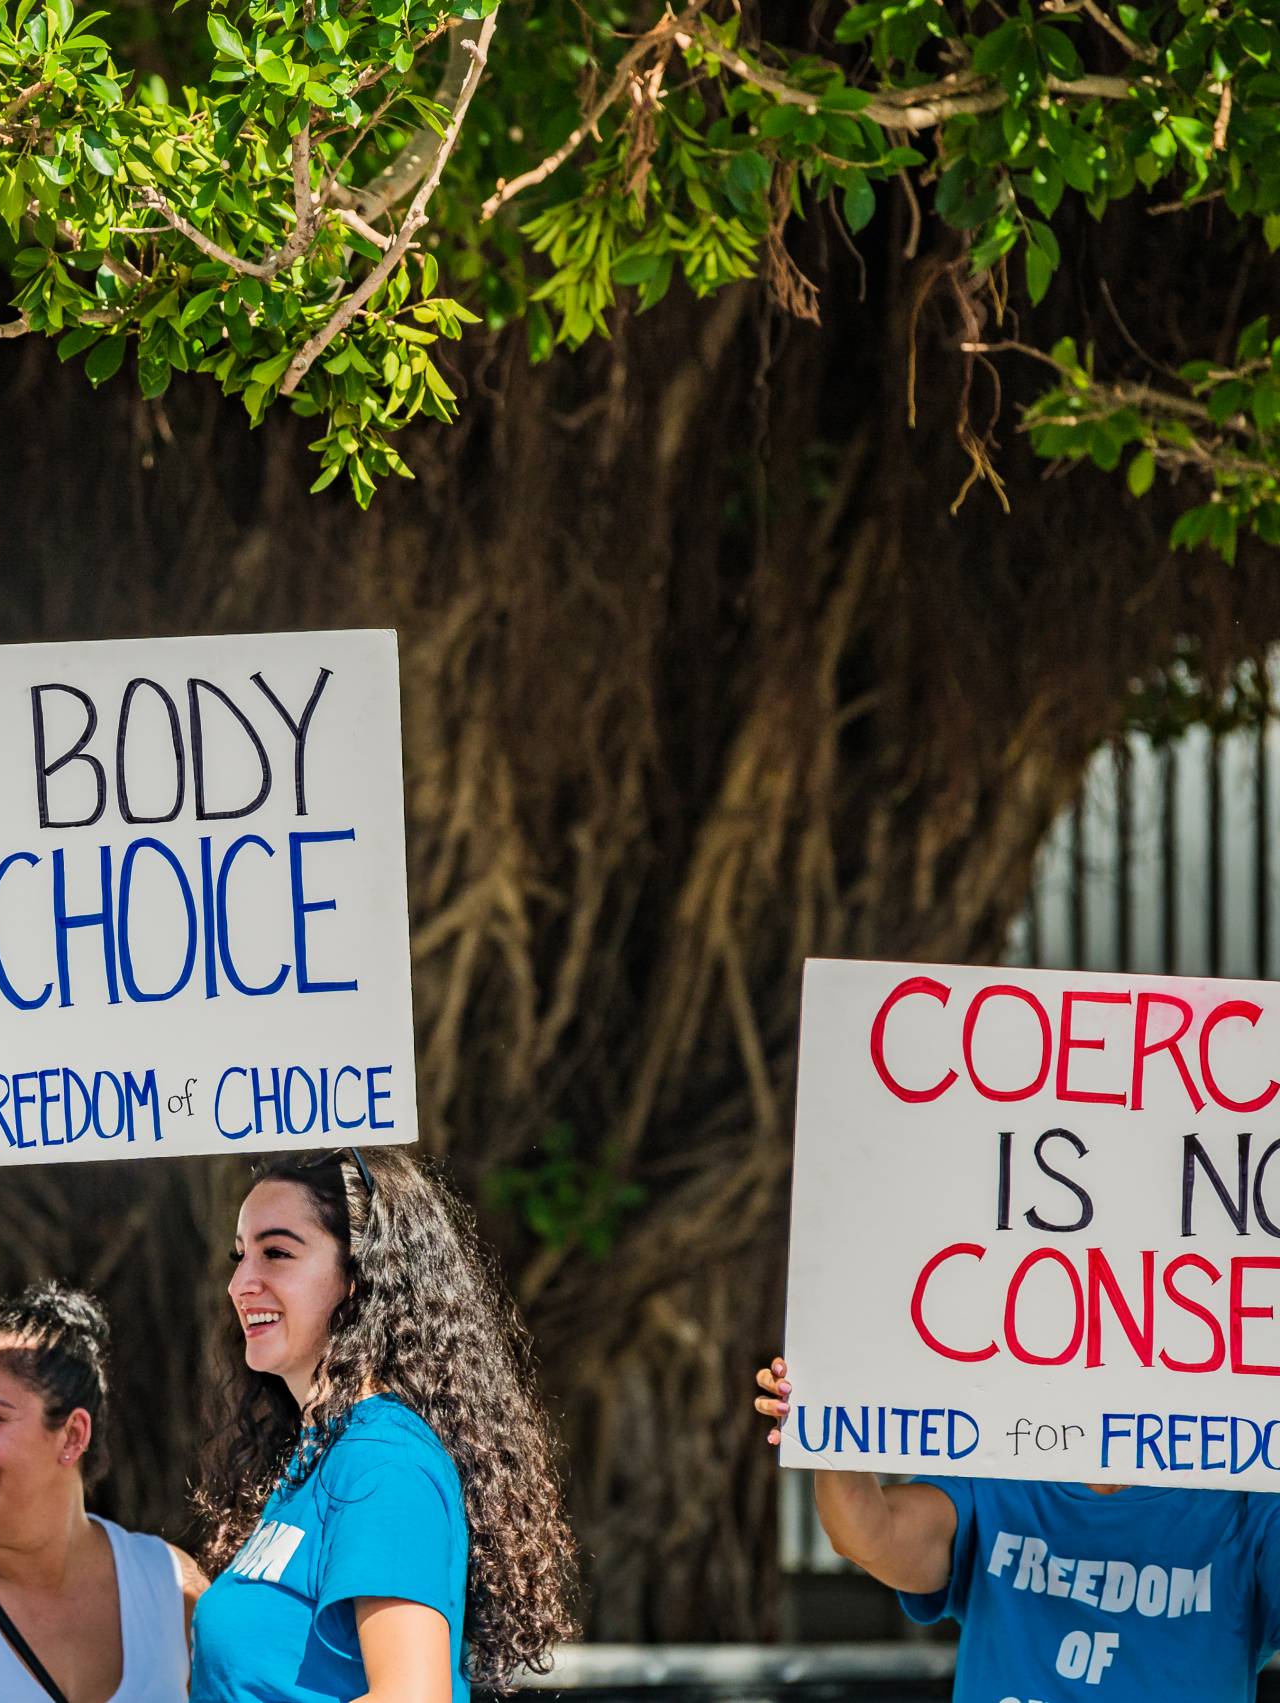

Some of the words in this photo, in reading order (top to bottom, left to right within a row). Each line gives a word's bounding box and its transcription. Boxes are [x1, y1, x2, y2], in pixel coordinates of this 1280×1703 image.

[31, 666, 334, 829] BODY
[869, 975, 1280, 1114] COERC
[168, 1078, 198, 1117] of
[213, 1064, 396, 1141] CHOICE
[995, 1127, 1094, 1233] IS
[909, 1242, 1280, 1377] CONSE
[797, 1405, 980, 1461] UNITED
[1006, 1418, 1086, 1457] for
[987, 1531, 1213, 1618] FREEDOM
[1055, 1630, 1120, 1685] OF
